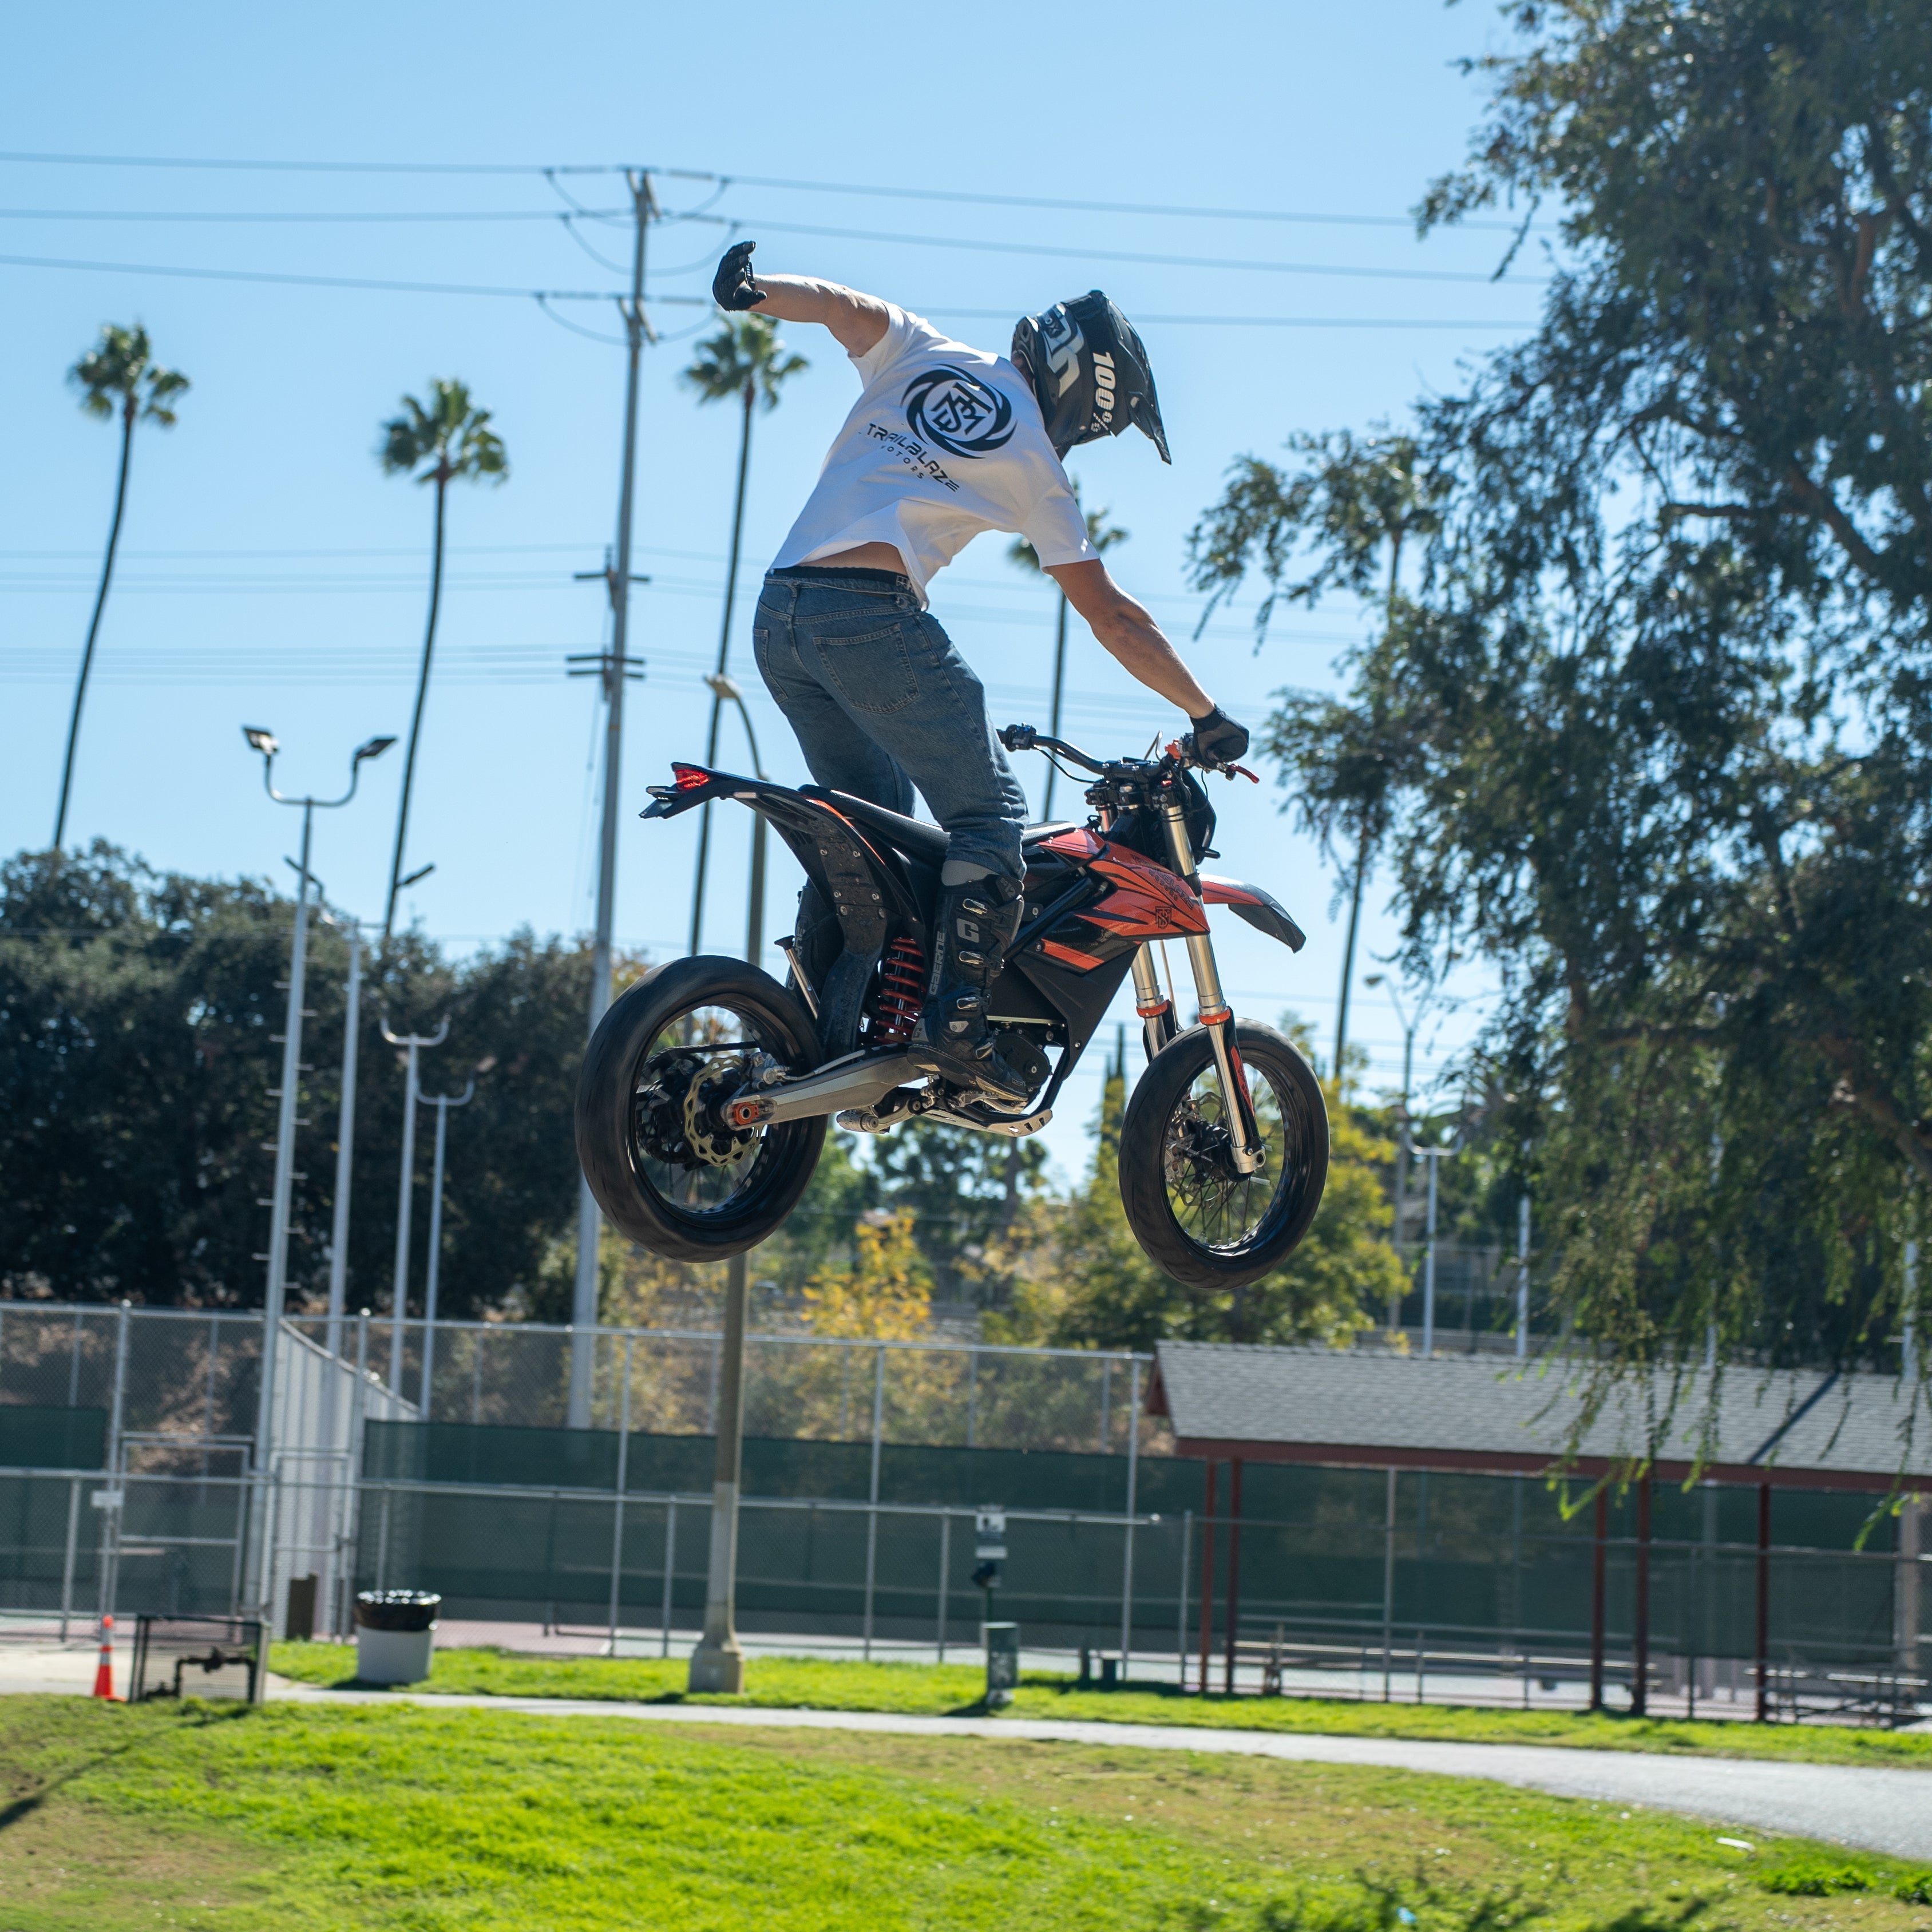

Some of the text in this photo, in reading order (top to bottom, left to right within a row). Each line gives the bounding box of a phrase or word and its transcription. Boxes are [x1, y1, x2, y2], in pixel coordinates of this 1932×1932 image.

[1091, 351, 1116, 433] 100%
[867, 423, 960, 492] TRAILBLAZE
[880, 445, 925, 480] OTORS
[956, 918, 980, 944] G
